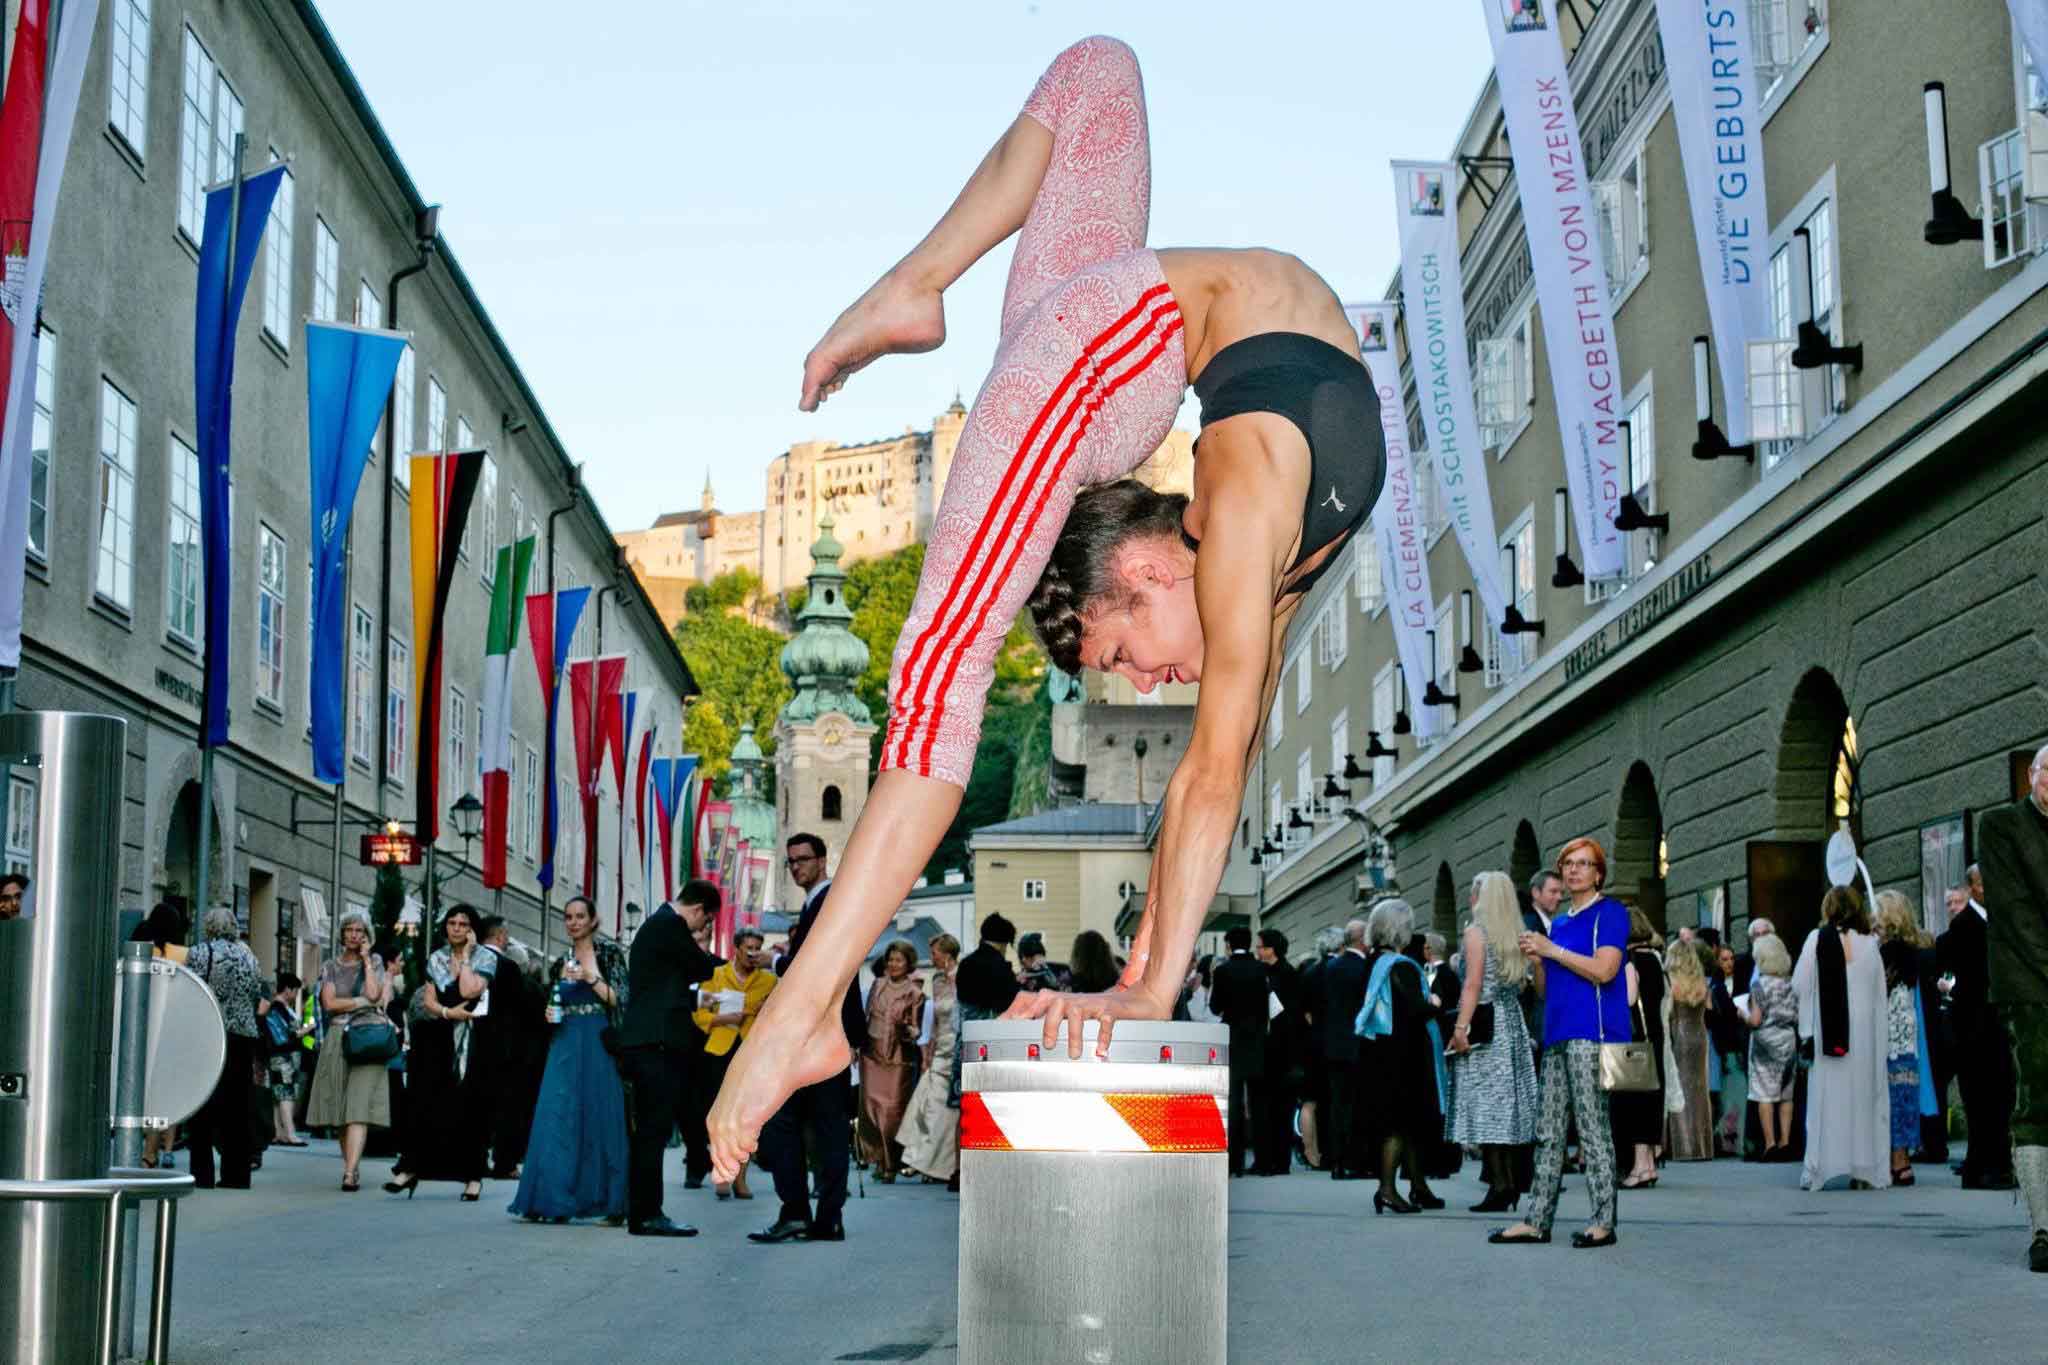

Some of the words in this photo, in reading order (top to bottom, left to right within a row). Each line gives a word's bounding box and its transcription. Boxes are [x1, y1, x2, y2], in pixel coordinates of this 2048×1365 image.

[1535, 76, 1577, 194] MZENSK
[1705, 0, 1747, 199] GEBURTS
[1559, 204, 1592, 275] VON
[1421, 253, 1464, 487] SCHOSTAKOWITSCH
[1573, 284, 1618, 445] MACBETH
[1387, 438, 1404, 460] DI
[1391, 467, 1422, 592] CLEMENZA
[1409, 599, 1427, 629] LA
